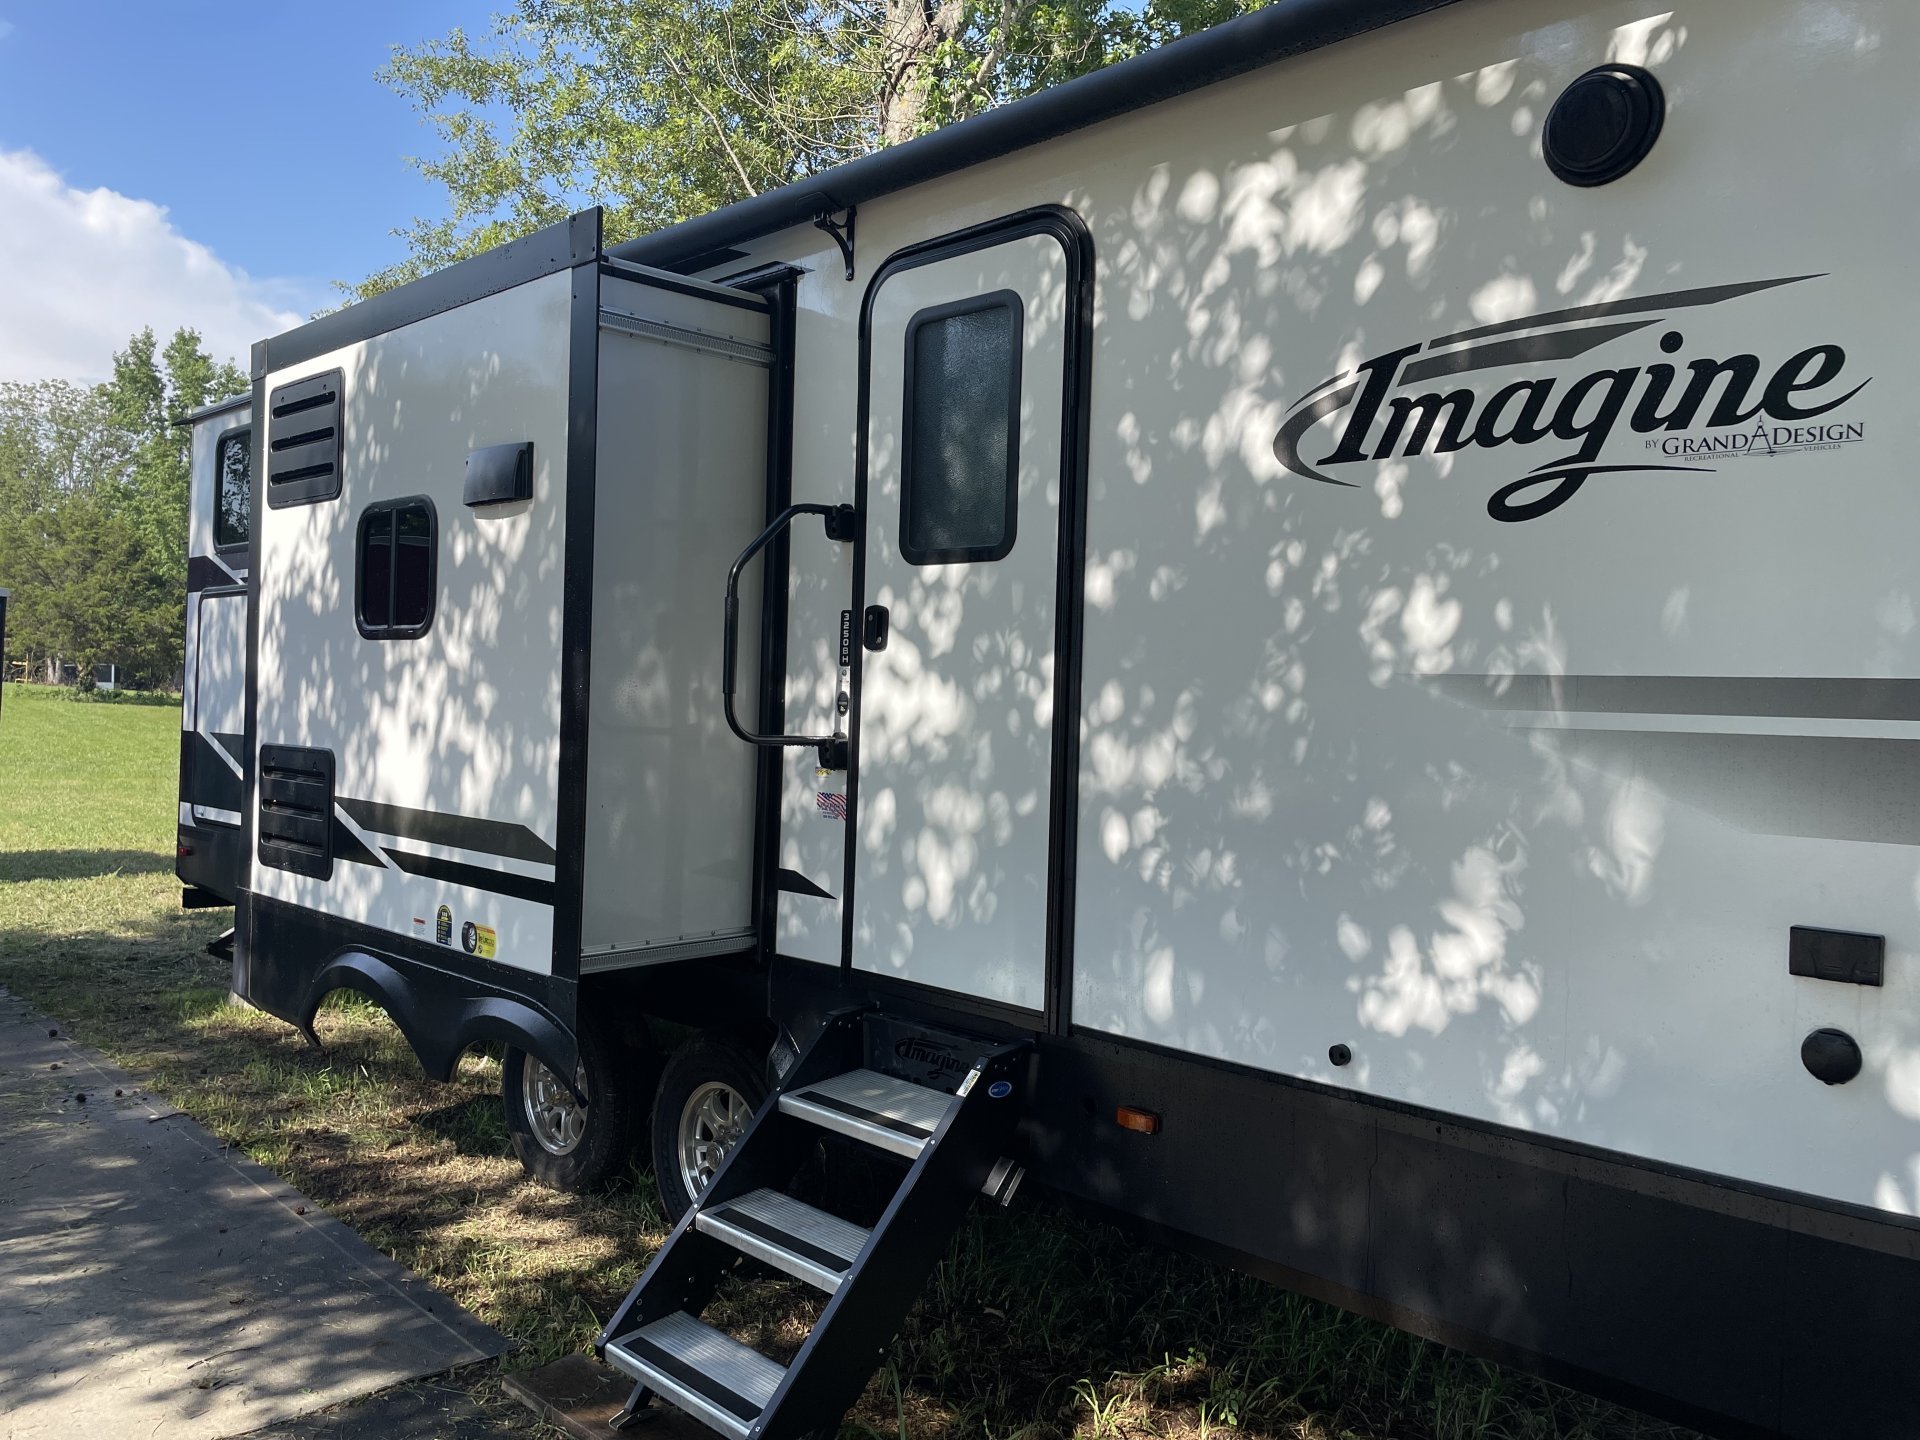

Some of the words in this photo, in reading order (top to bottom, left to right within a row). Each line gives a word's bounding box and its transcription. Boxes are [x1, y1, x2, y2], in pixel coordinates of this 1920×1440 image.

[1274, 330, 1874, 523] Imagine
[1645, 438, 1660, 449] BY
[1661, 433, 1749, 455] GRAND
[1772, 422, 1865, 446] DESIGN
[1684, 451, 1740, 462] RECREATIONAL
[1803, 443, 1842, 452] VEHICLES
[842, 612, 850, 664] 3250BH
[895, 1037, 971, 1080] Imagine
